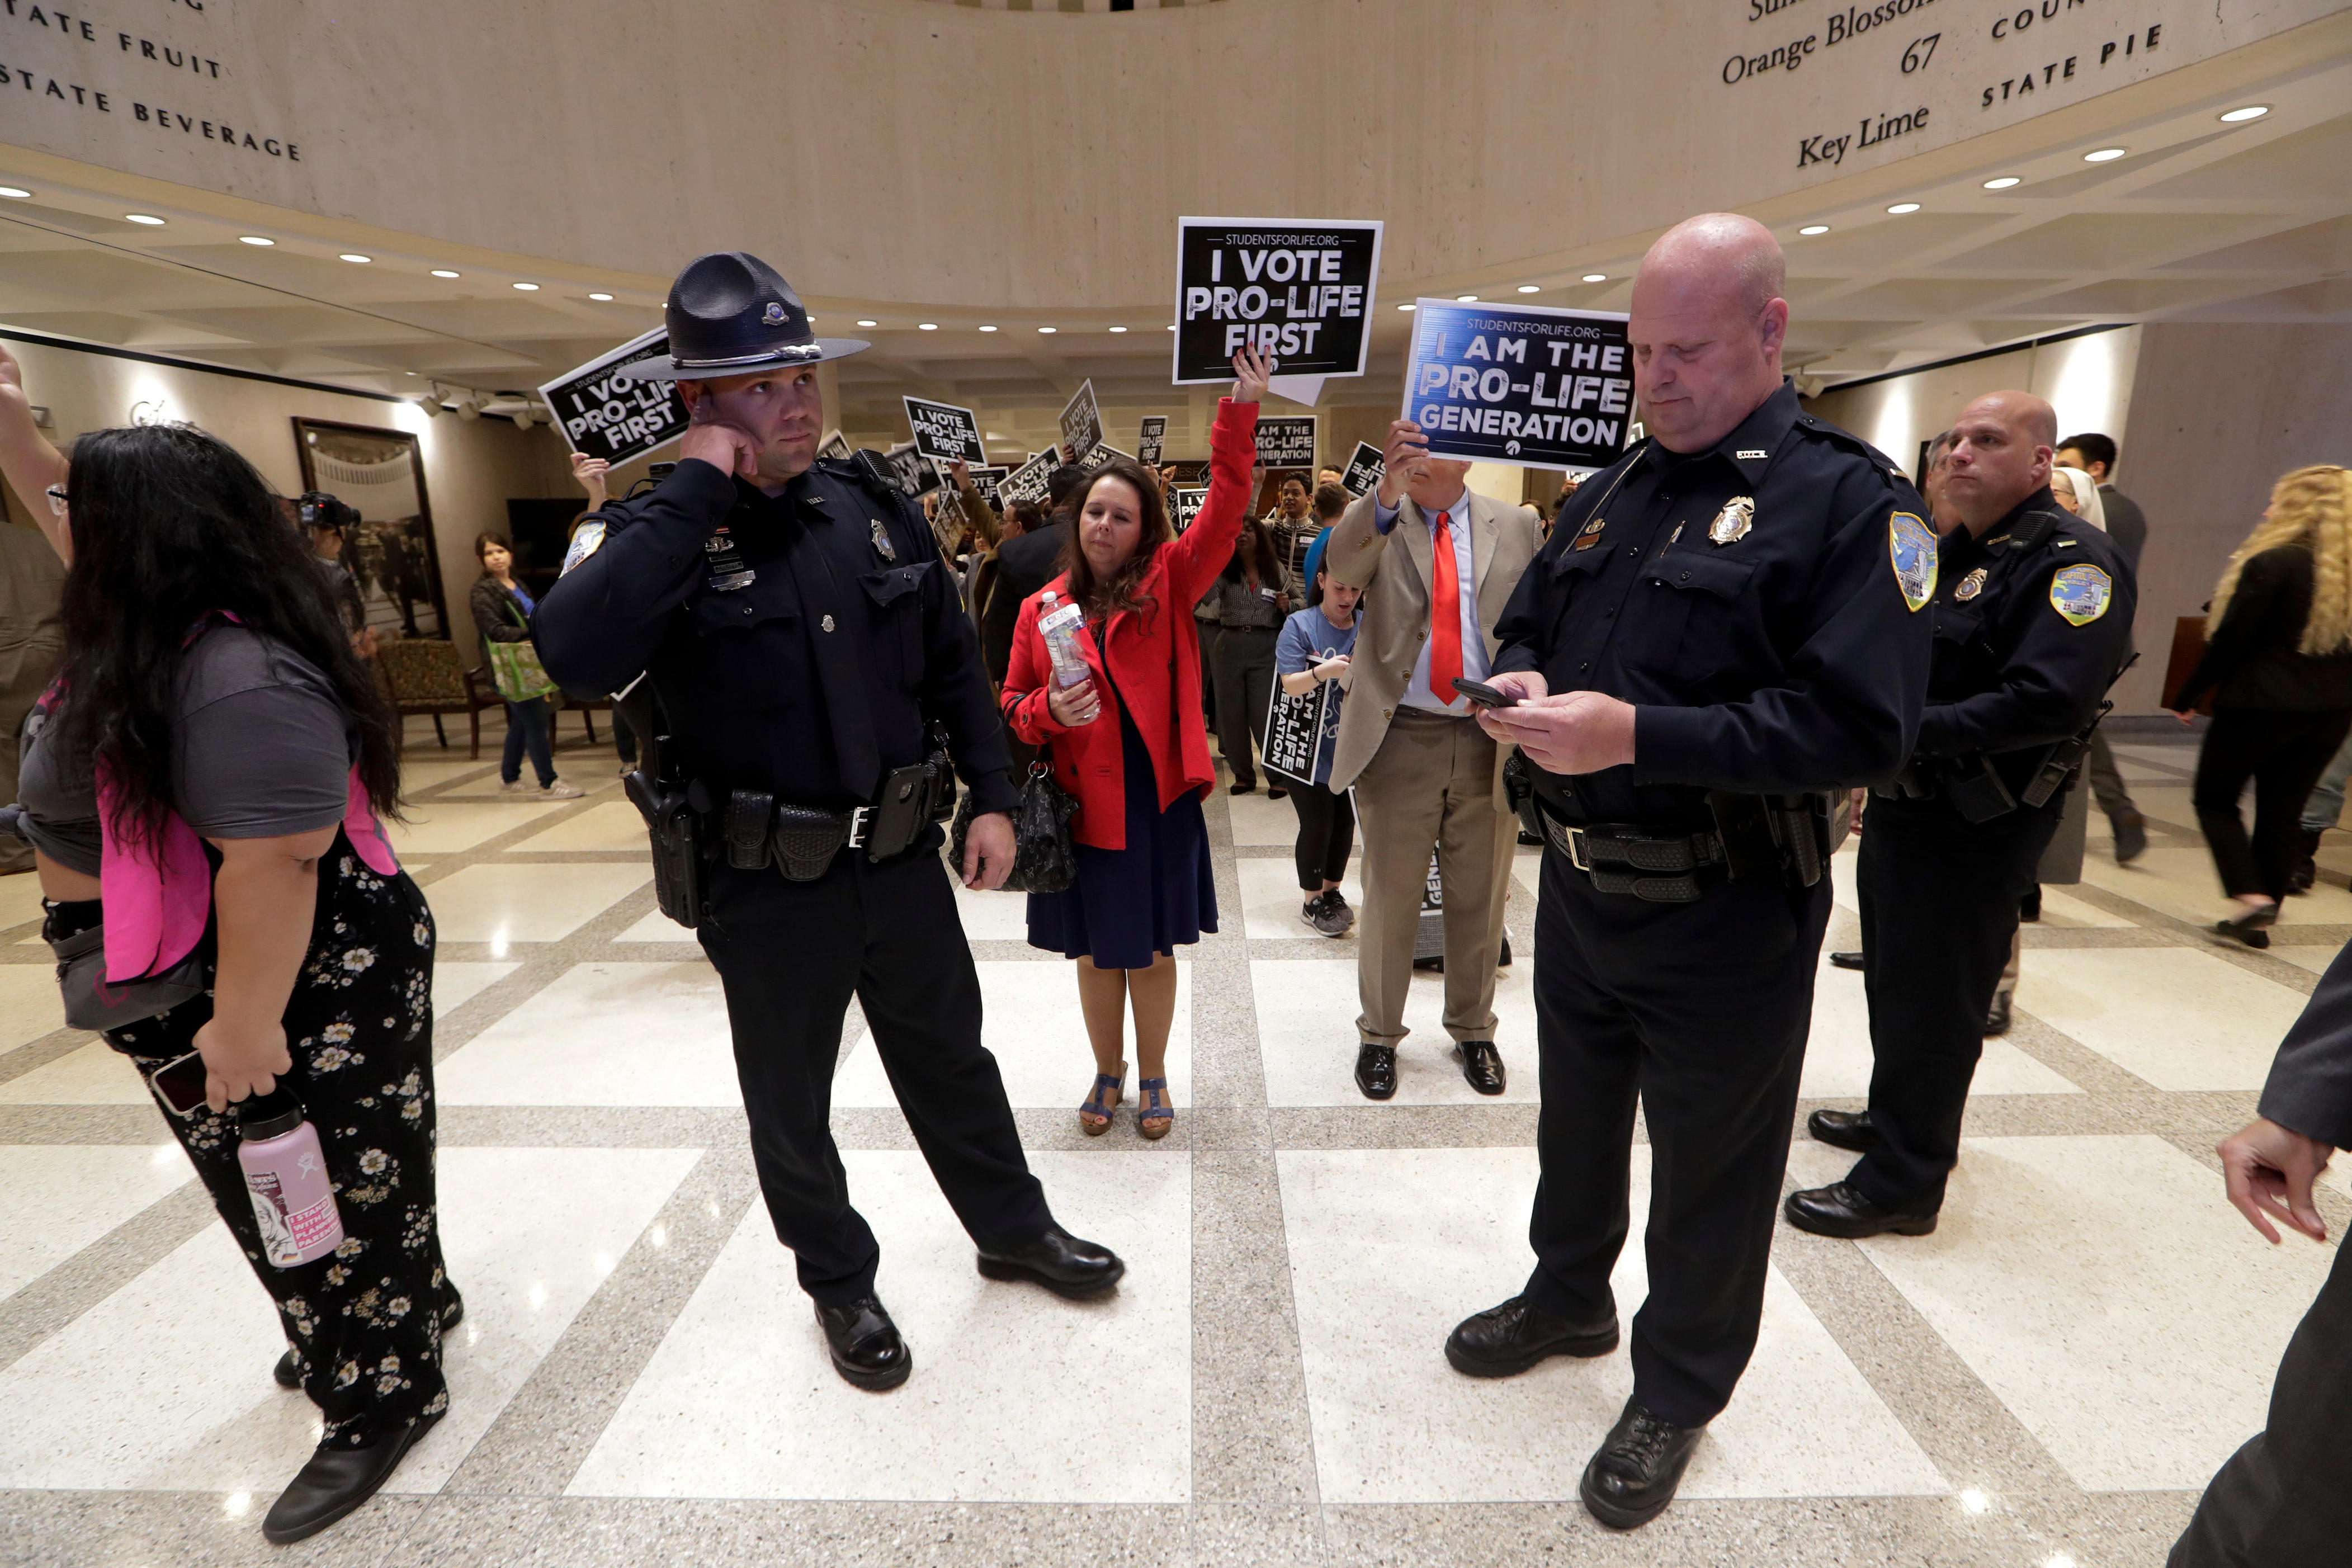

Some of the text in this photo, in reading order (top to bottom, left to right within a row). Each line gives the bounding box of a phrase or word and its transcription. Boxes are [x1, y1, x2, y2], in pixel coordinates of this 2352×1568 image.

[4, 0, 220, 78] TATE FRUIT
[1901, 32, 1942, 74] 67
[1722, 35, 1817, 84] Orange
[0, 63, 300, 162] STATE BEVERAGE
[1797, 23, 2162, 168] Key Lime STATE PIE
[1226, 233, 1339, 247] STUDENTSFORLIFE.ORG
[1211, 249, 1342, 282] I VOTE
[1186, 285, 1363, 321] PRO-LIFE
[1225, 322, 1322, 358] FIRST
[1466, 318, 1601, 339] STUDENTSFORLIFE.ORG
[1435, 332, 1626, 372] I AM THE
[571, 393, 586, 413] I
[1418, 362, 1631, 415] PRO-LIFE
[566, 380, 677, 441] PRO-LIF
[604, 401, 676, 450] FIRST
[917, 408, 924, 421] I
[926, 410, 965, 428] VOTE
[1065, 405, 1097, 445] PRO-LIFE
[1069, 398, 1088, 427] VOTE
[1419, 404, 1619, 447] GENERATION
[913, 420, 977, 443] PRO-LIFE
[931, 436, 966, 454] FIRST
[1074, 427, 1092, 456] FIRST
[1148, 424, 1163, 436] VOTE
[1255, 436, 1313, 449] RO-LIFE
[1258, 426, 1310, 436] AM THE
[1142, 447, 1157, 460] FIRST
[1256, 449, 1311, 460] ENERATION
[970, 476, 995, 488] OTE
[1004, 460, 1060, 505] PRO-LIFE
[1007, 484, 1013, 492] I
[1015, 458, 1049, 485] VOTE
[1272, 688, 1290, 765] ERATION
[1282, 695, 1304, 772] O-LIFE
[1307, 687, 1323, 758] STUDENTSFORLIFE.ORG
[1295, 729, 1310, 771] THE
[292, 1213, 323, 1231] WITH
[296, 1200, 327, 1222] STAND
